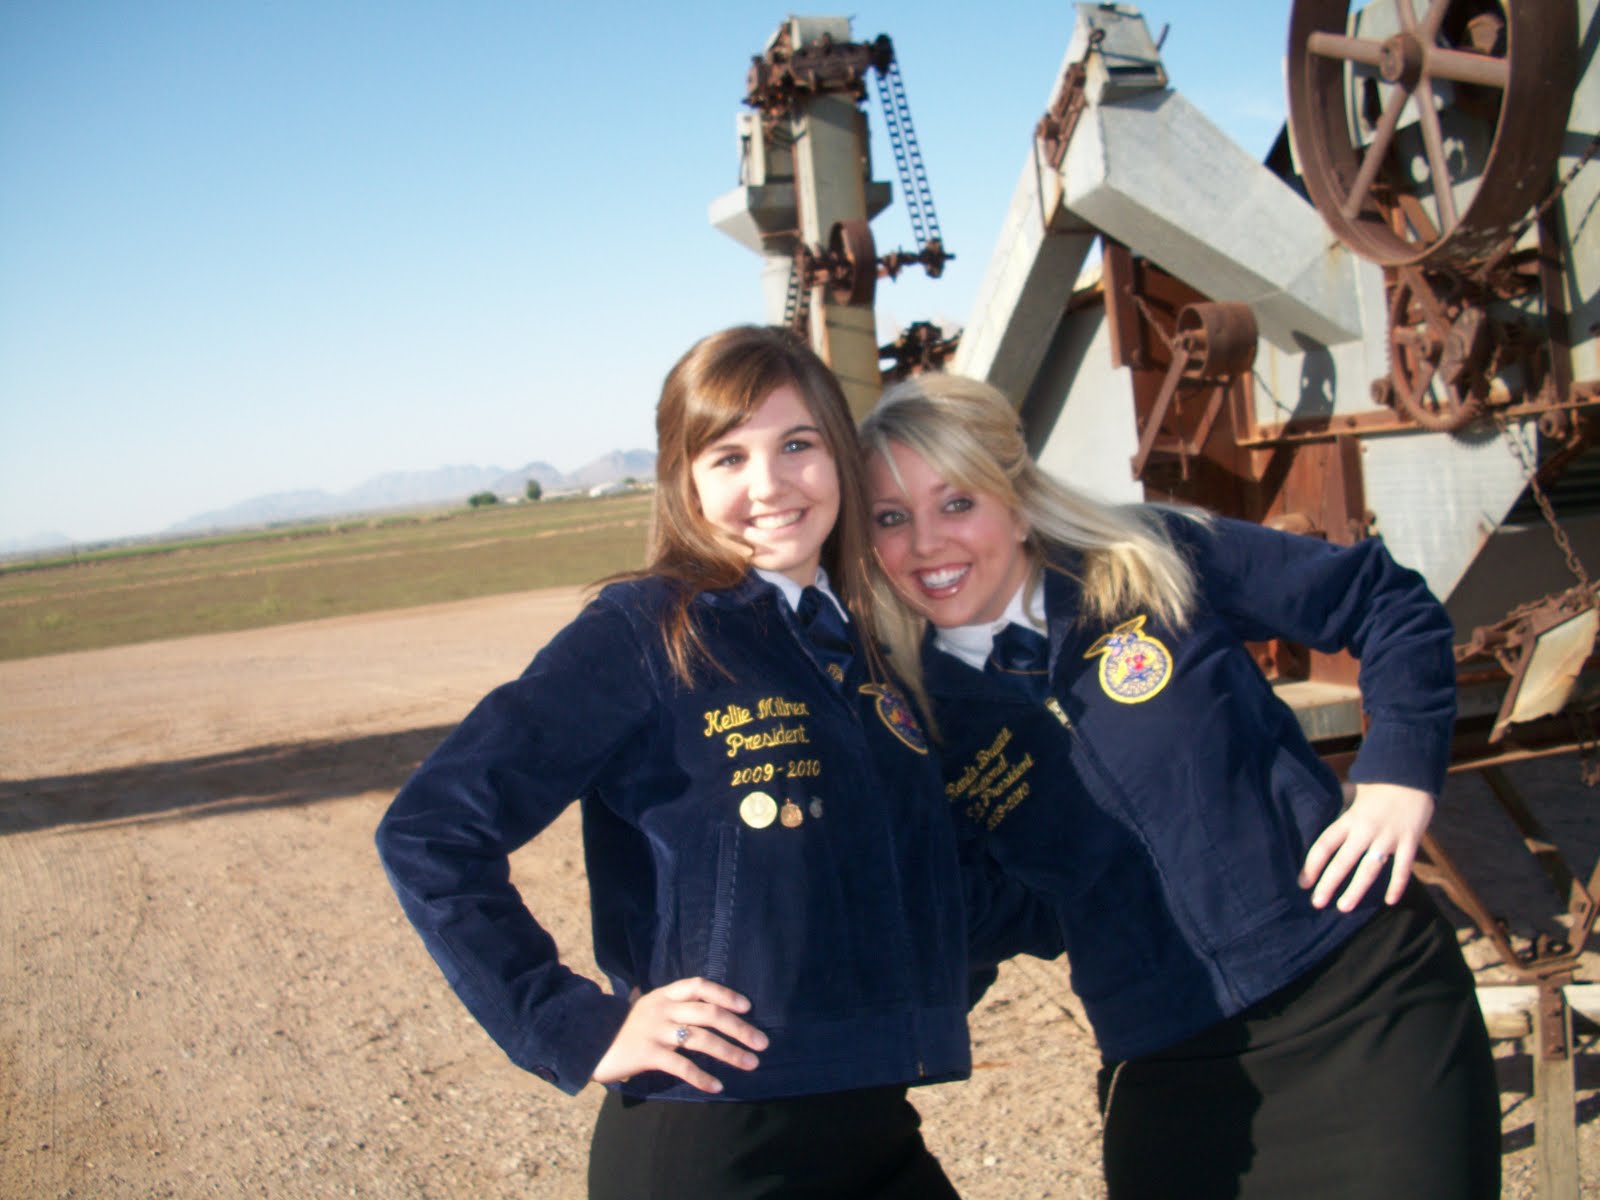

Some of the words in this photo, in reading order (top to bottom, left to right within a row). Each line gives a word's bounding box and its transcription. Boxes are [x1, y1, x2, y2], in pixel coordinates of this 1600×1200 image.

[704, 704, 753, 737] Kellie
[726, 723, 810, 757] President
[731, 760, 821, 786] 2009-2010
